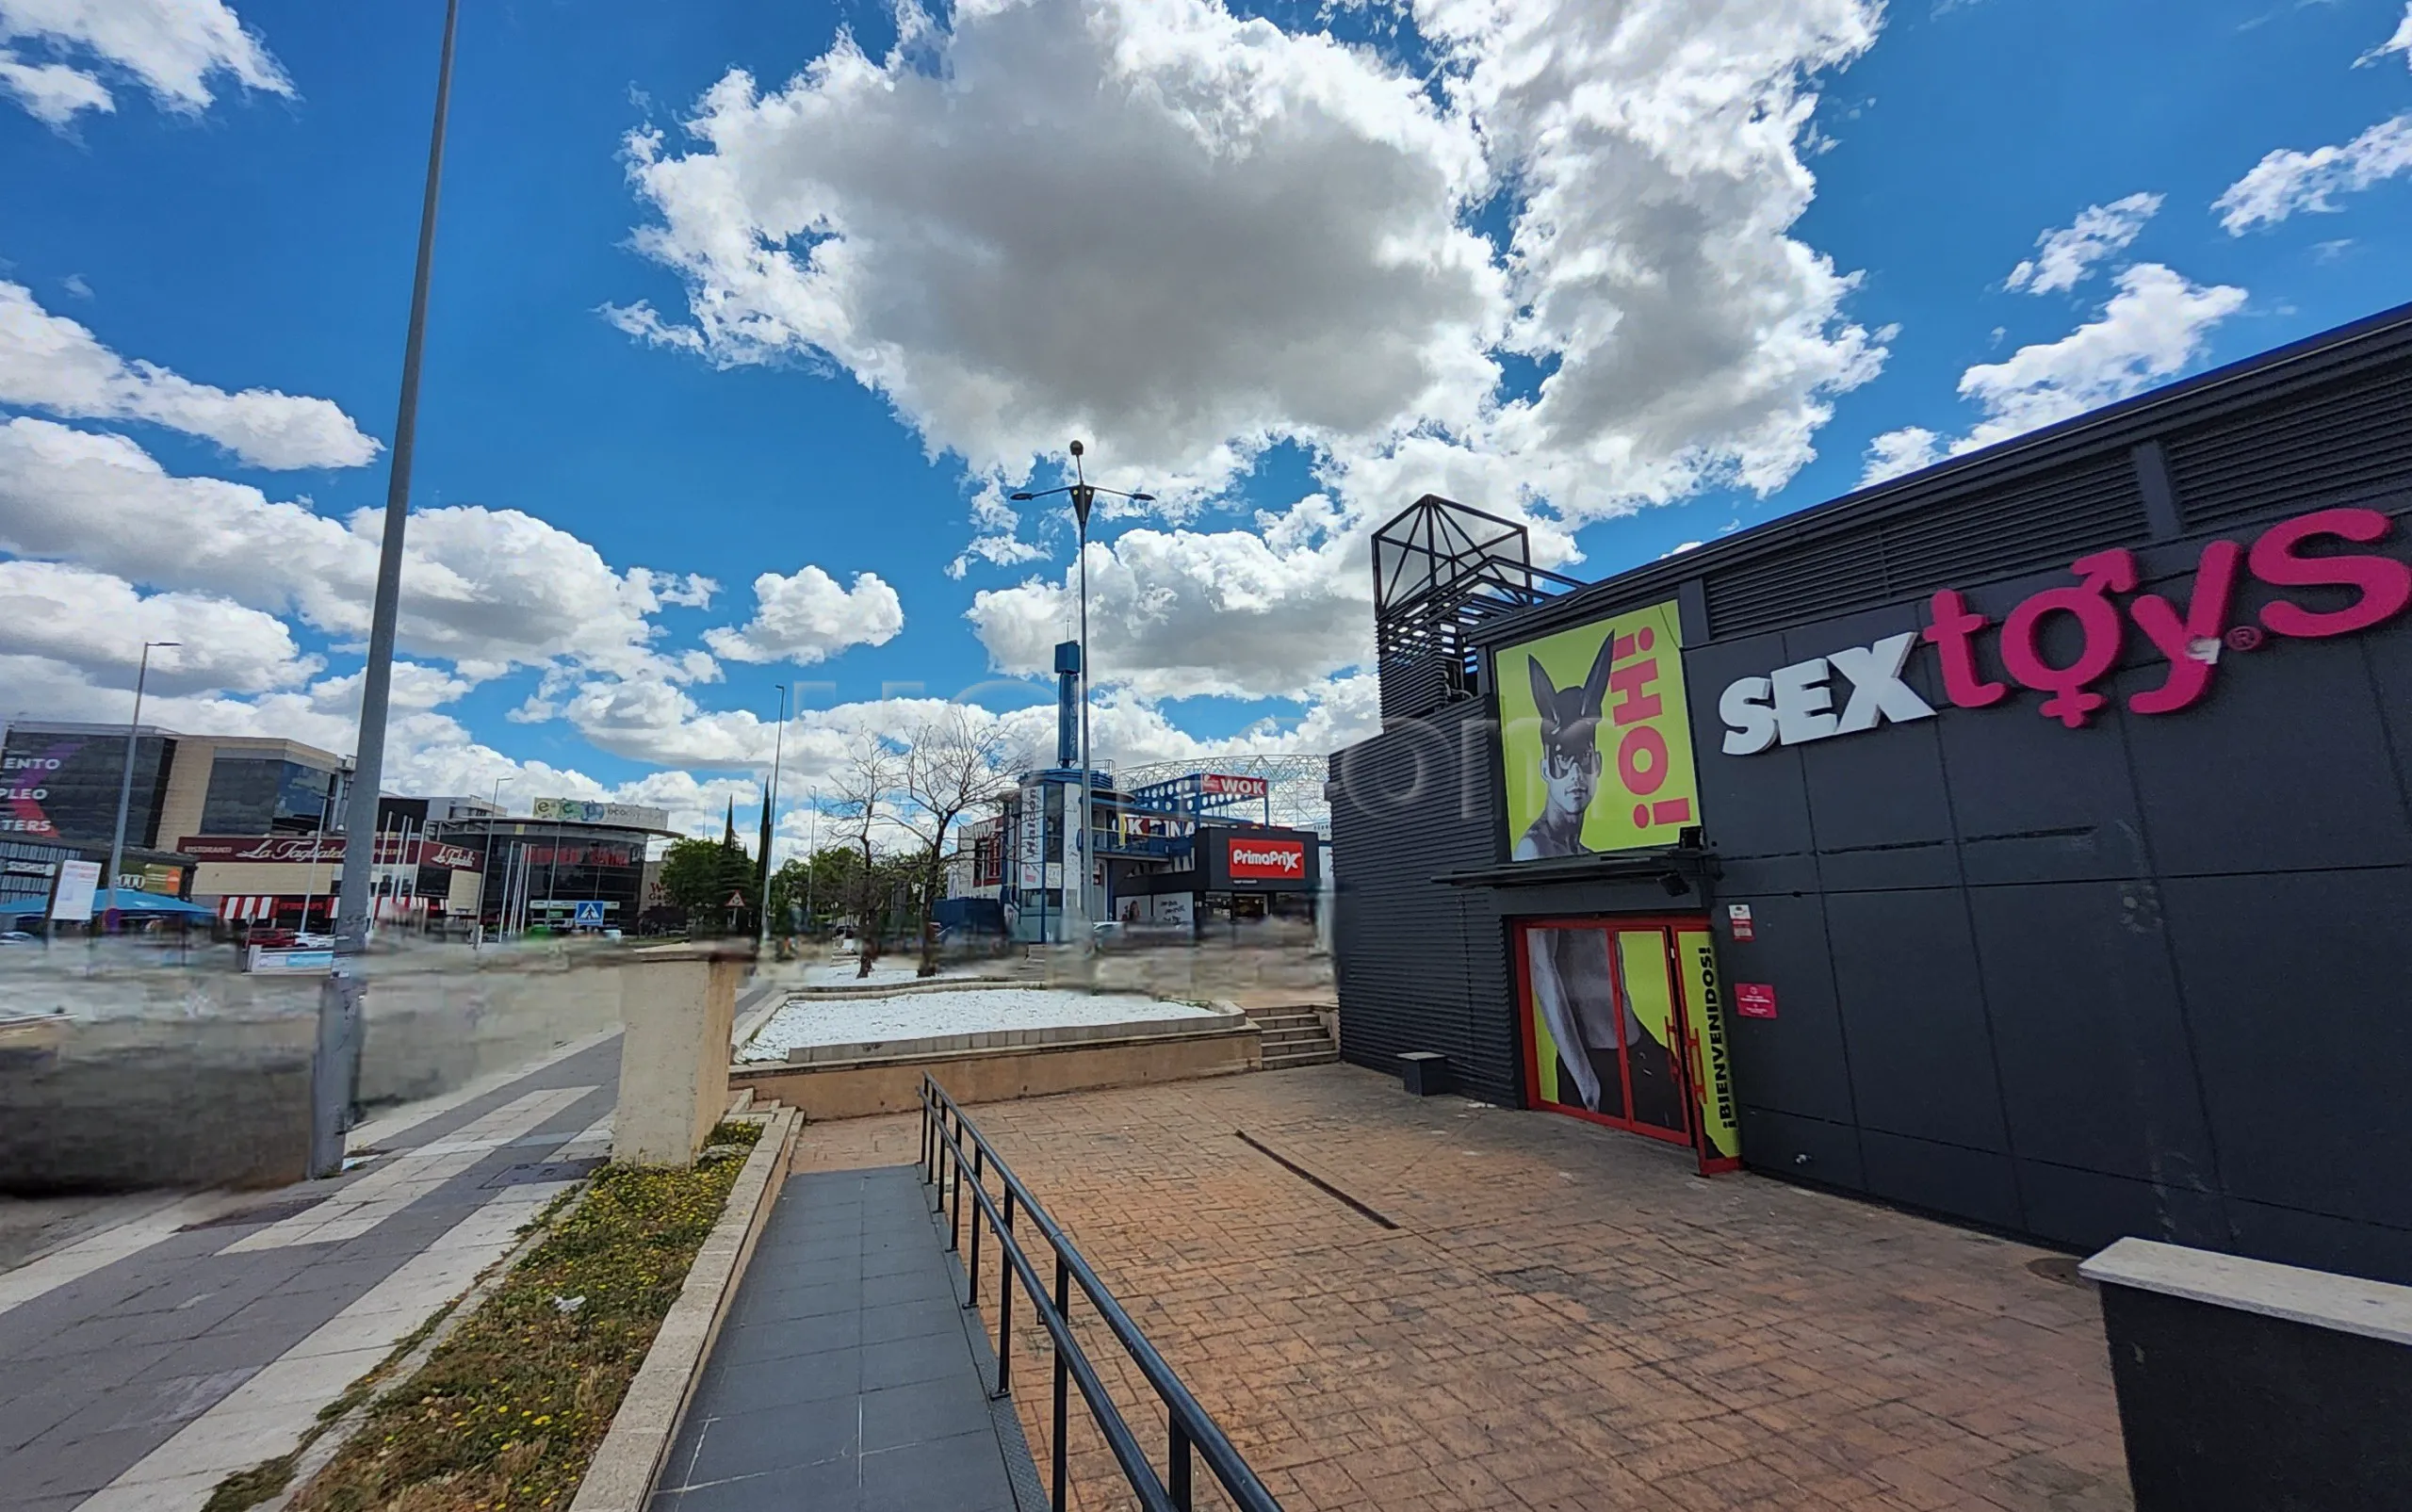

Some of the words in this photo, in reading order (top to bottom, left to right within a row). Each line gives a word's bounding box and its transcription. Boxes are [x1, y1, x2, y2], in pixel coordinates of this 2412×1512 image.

[1719, 631, 1938, 755] SEX
[1220, 779, 1264, 795] WOK
[1699, 946, 1738, 1130] ¡BIENVENIDOS!
